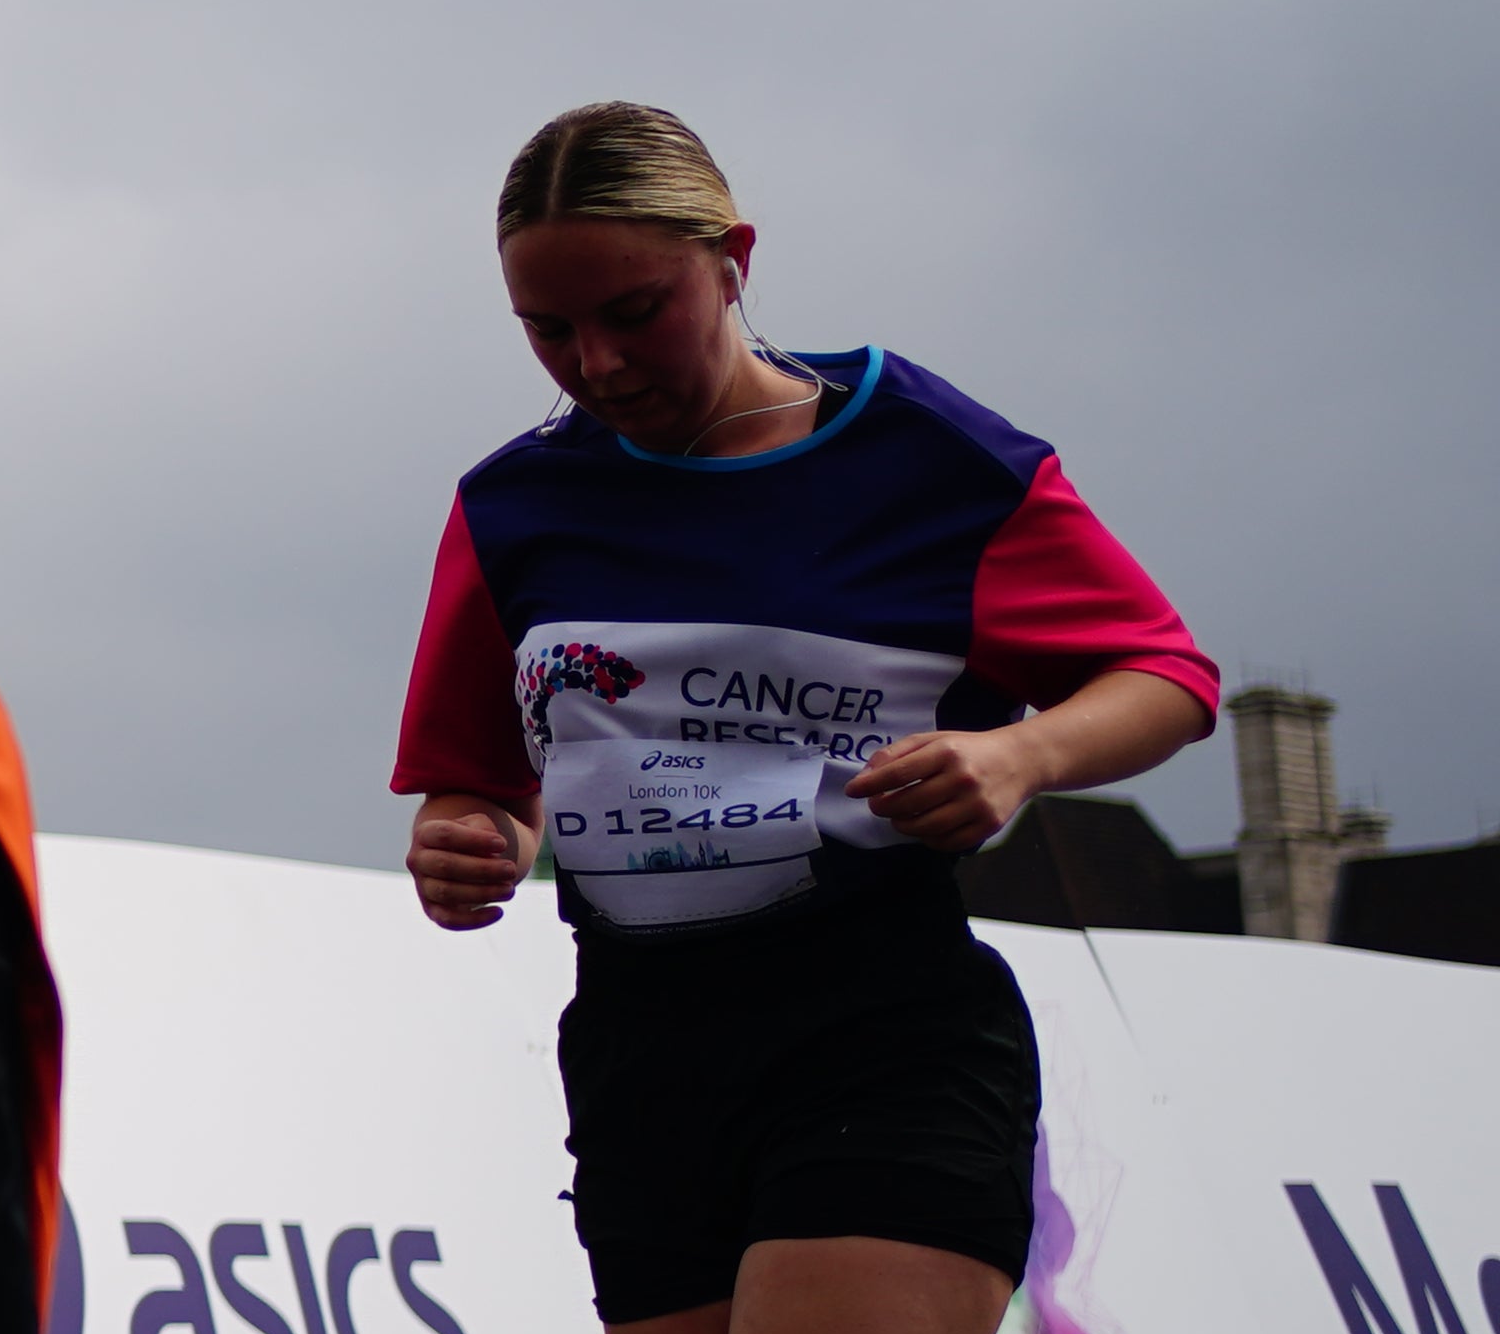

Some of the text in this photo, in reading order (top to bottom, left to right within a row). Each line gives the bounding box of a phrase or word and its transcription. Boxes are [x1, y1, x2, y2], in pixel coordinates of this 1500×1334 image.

[680, 667, 884, 724] CANCER
[680, 718, 893, 763] RESERC
[661, 754, 706, 770] asics
[628, 783, 722, 800] London 10K
